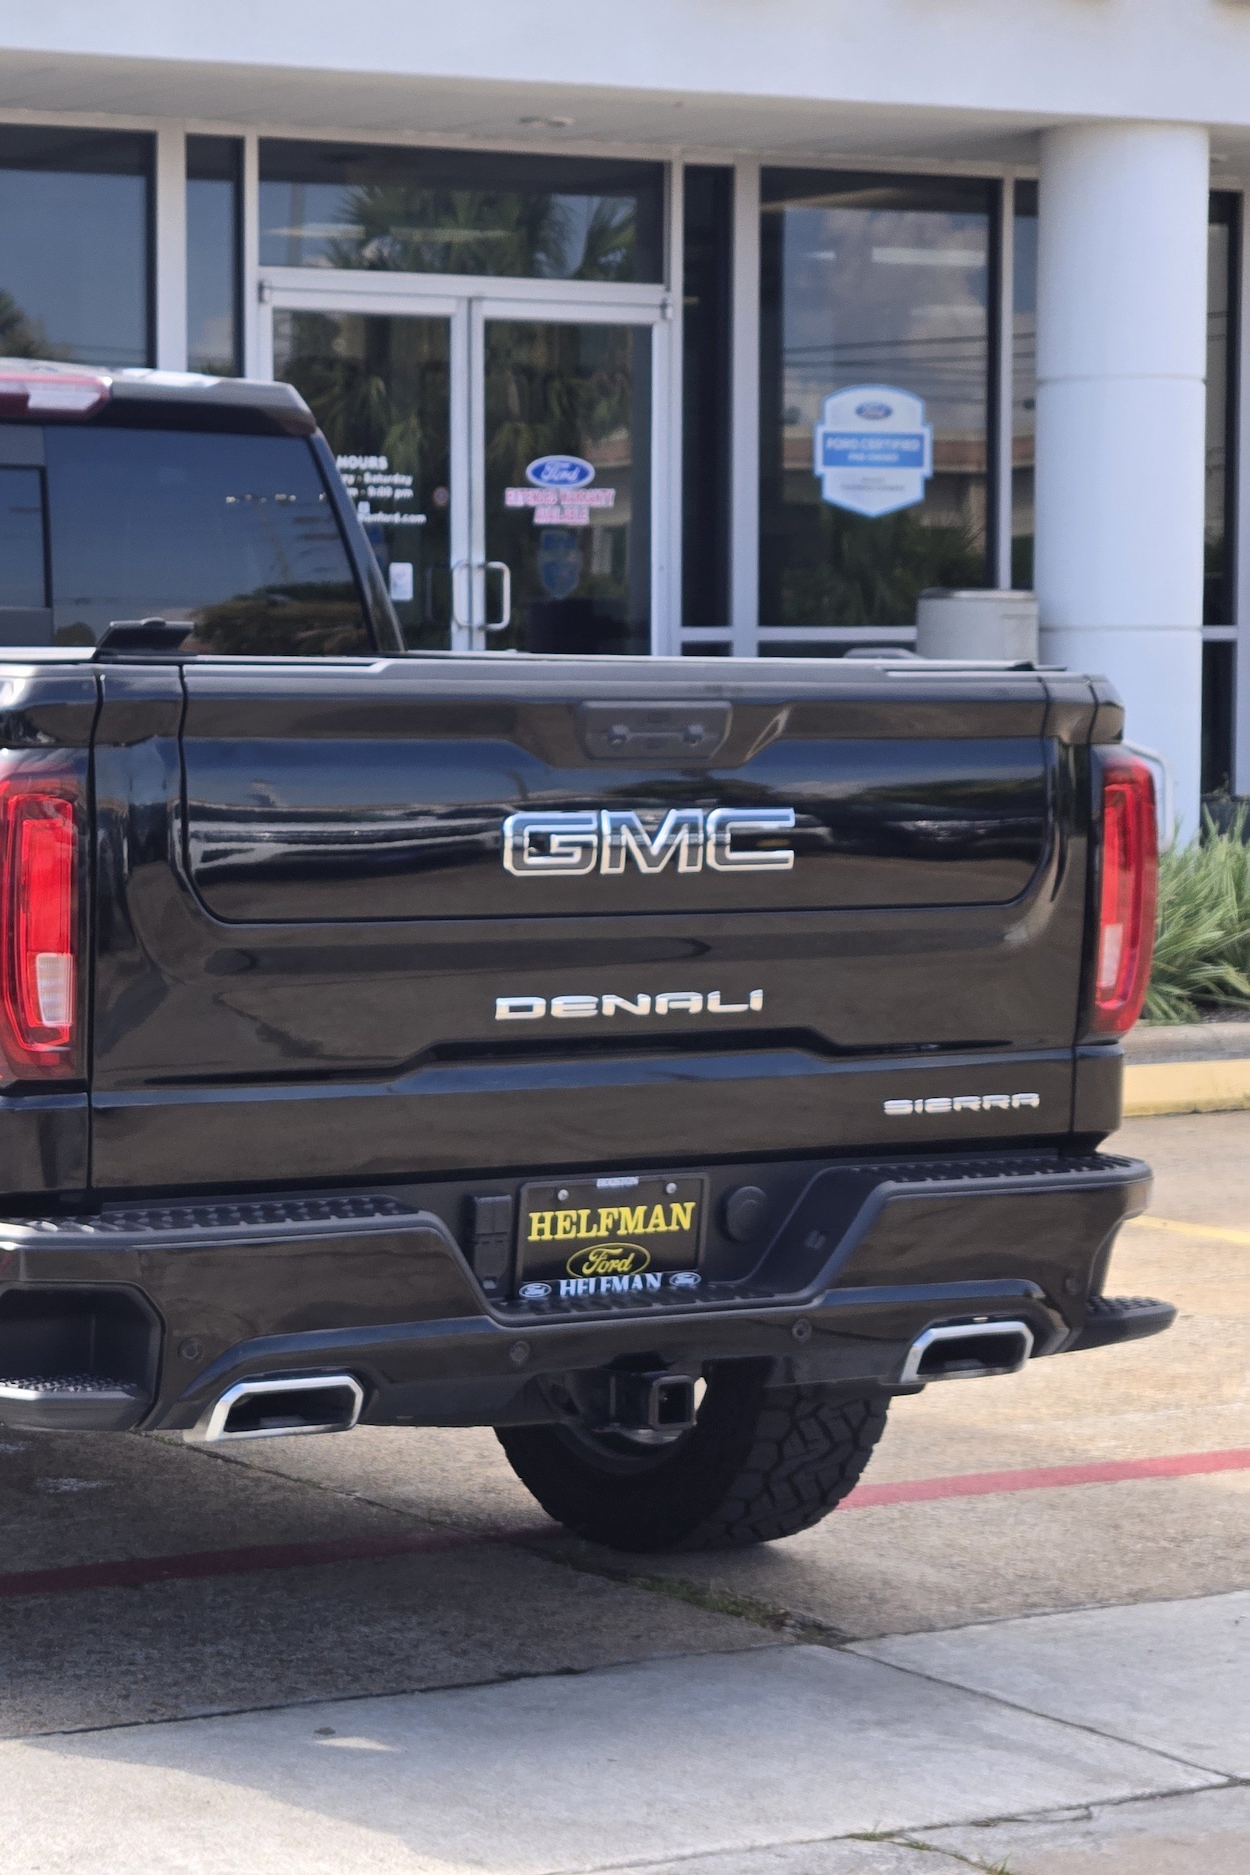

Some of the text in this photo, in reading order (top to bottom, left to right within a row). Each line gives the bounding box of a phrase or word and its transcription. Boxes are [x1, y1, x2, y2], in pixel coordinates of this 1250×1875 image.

[336, 455, 388, 471] HOURS
[503, 807, 796, 877] GMC
[495, 988, 764, 1020] DENALI
[883, 1092, 1040, 1116] SIERRA
[527, 1202, 697, 1241] HELFMAN
[582, 1247, 635, 1275] Ford
